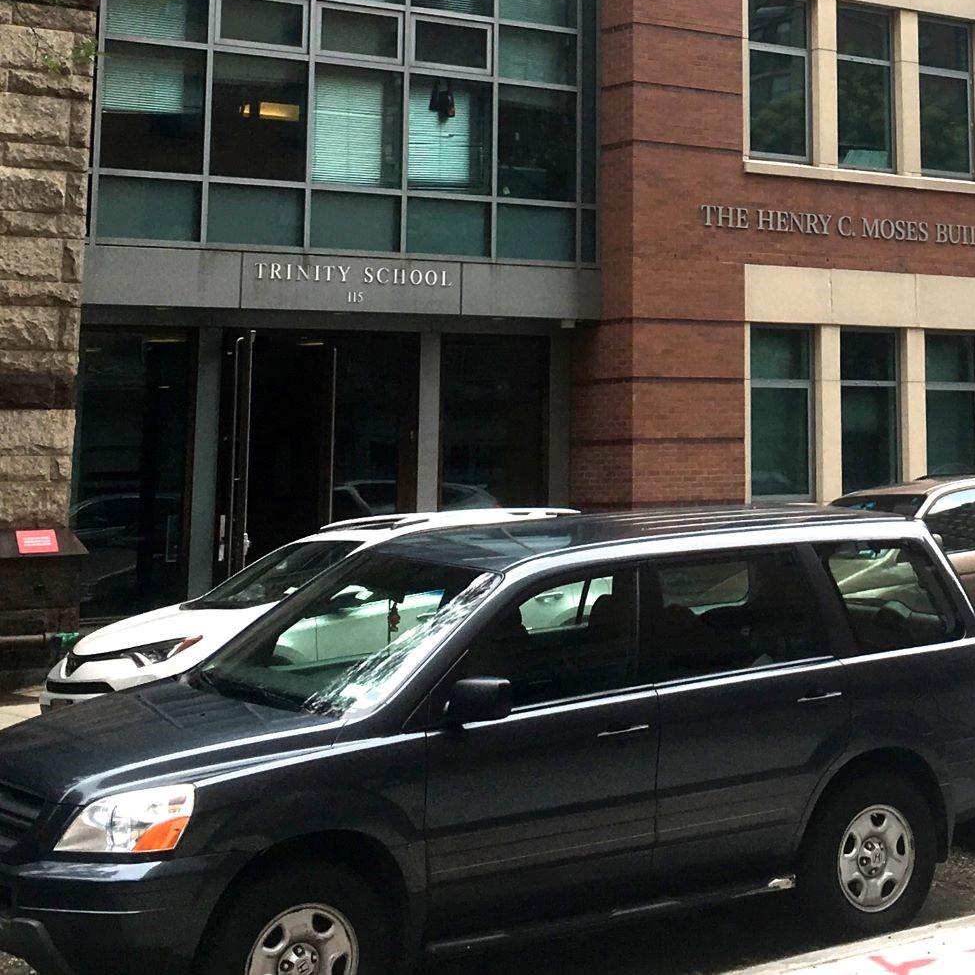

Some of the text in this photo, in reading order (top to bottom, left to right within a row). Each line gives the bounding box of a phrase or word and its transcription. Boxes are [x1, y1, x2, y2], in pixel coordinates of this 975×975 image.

[701, 204, 750, 230] THE
[757, 209, 833, 236] HENRY
[838, 216, 857, 238] C.
[862, 217, 929, 242] MOSES
[255, 263, 453, 287] TRINITY SCHOOL
[347, 291, 364, 304] 115
